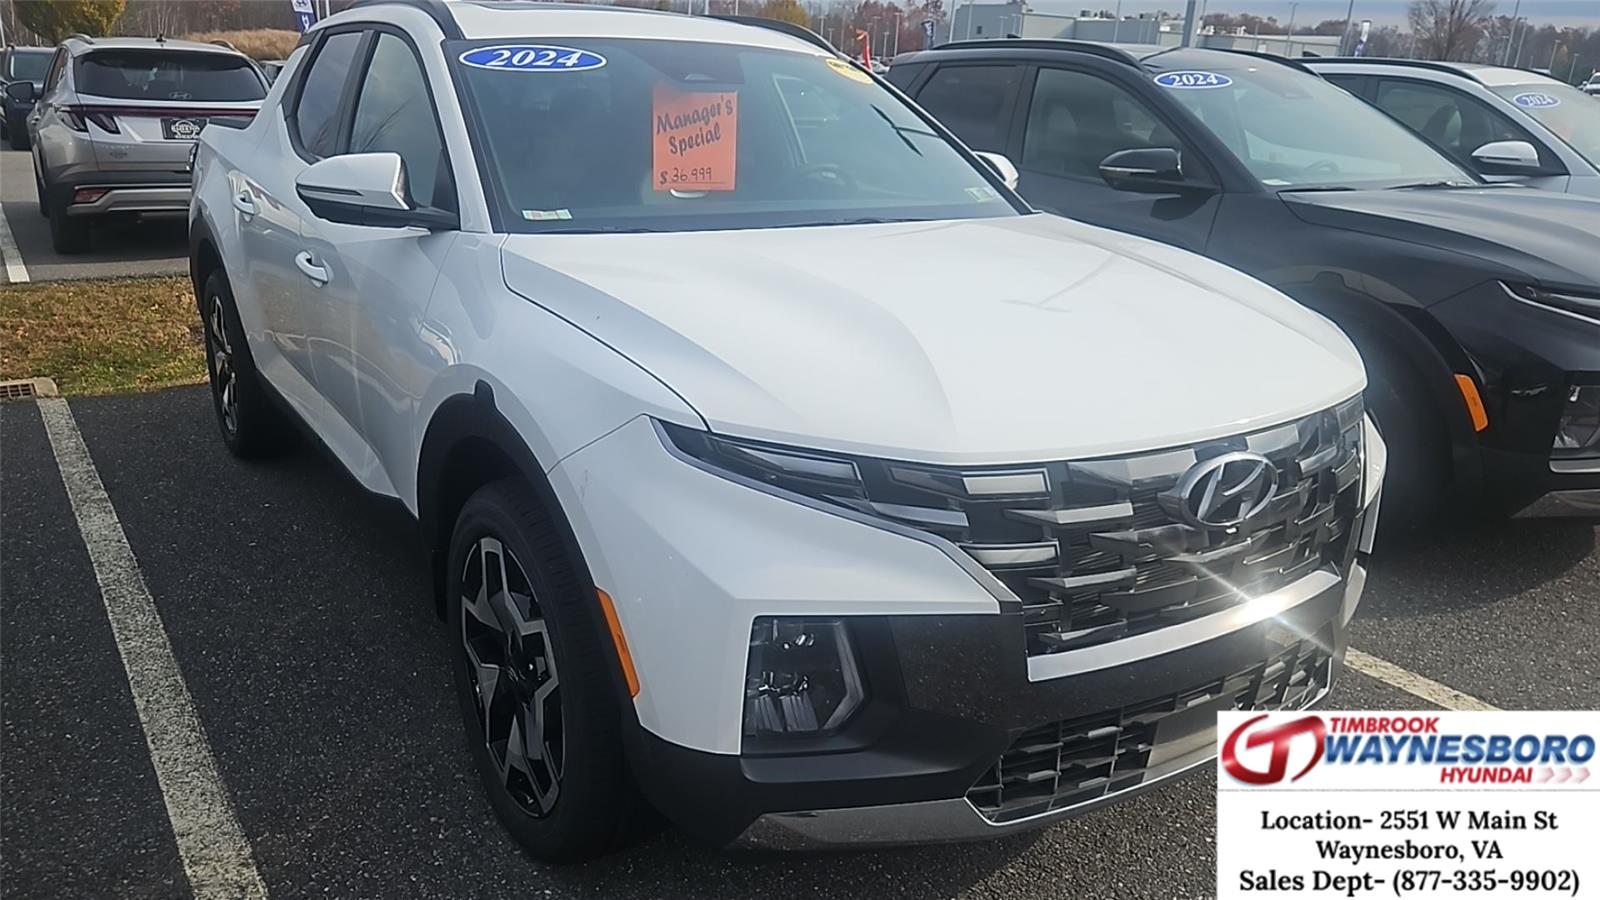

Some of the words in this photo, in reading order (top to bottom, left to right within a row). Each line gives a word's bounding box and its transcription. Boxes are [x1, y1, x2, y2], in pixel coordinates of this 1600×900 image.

[485, 49, 582, 67] 2024
[1169, 74, 1218, 86] 2024
[656, 95, 733, 135] Manager's
[668, 122, 720, 157] Special
